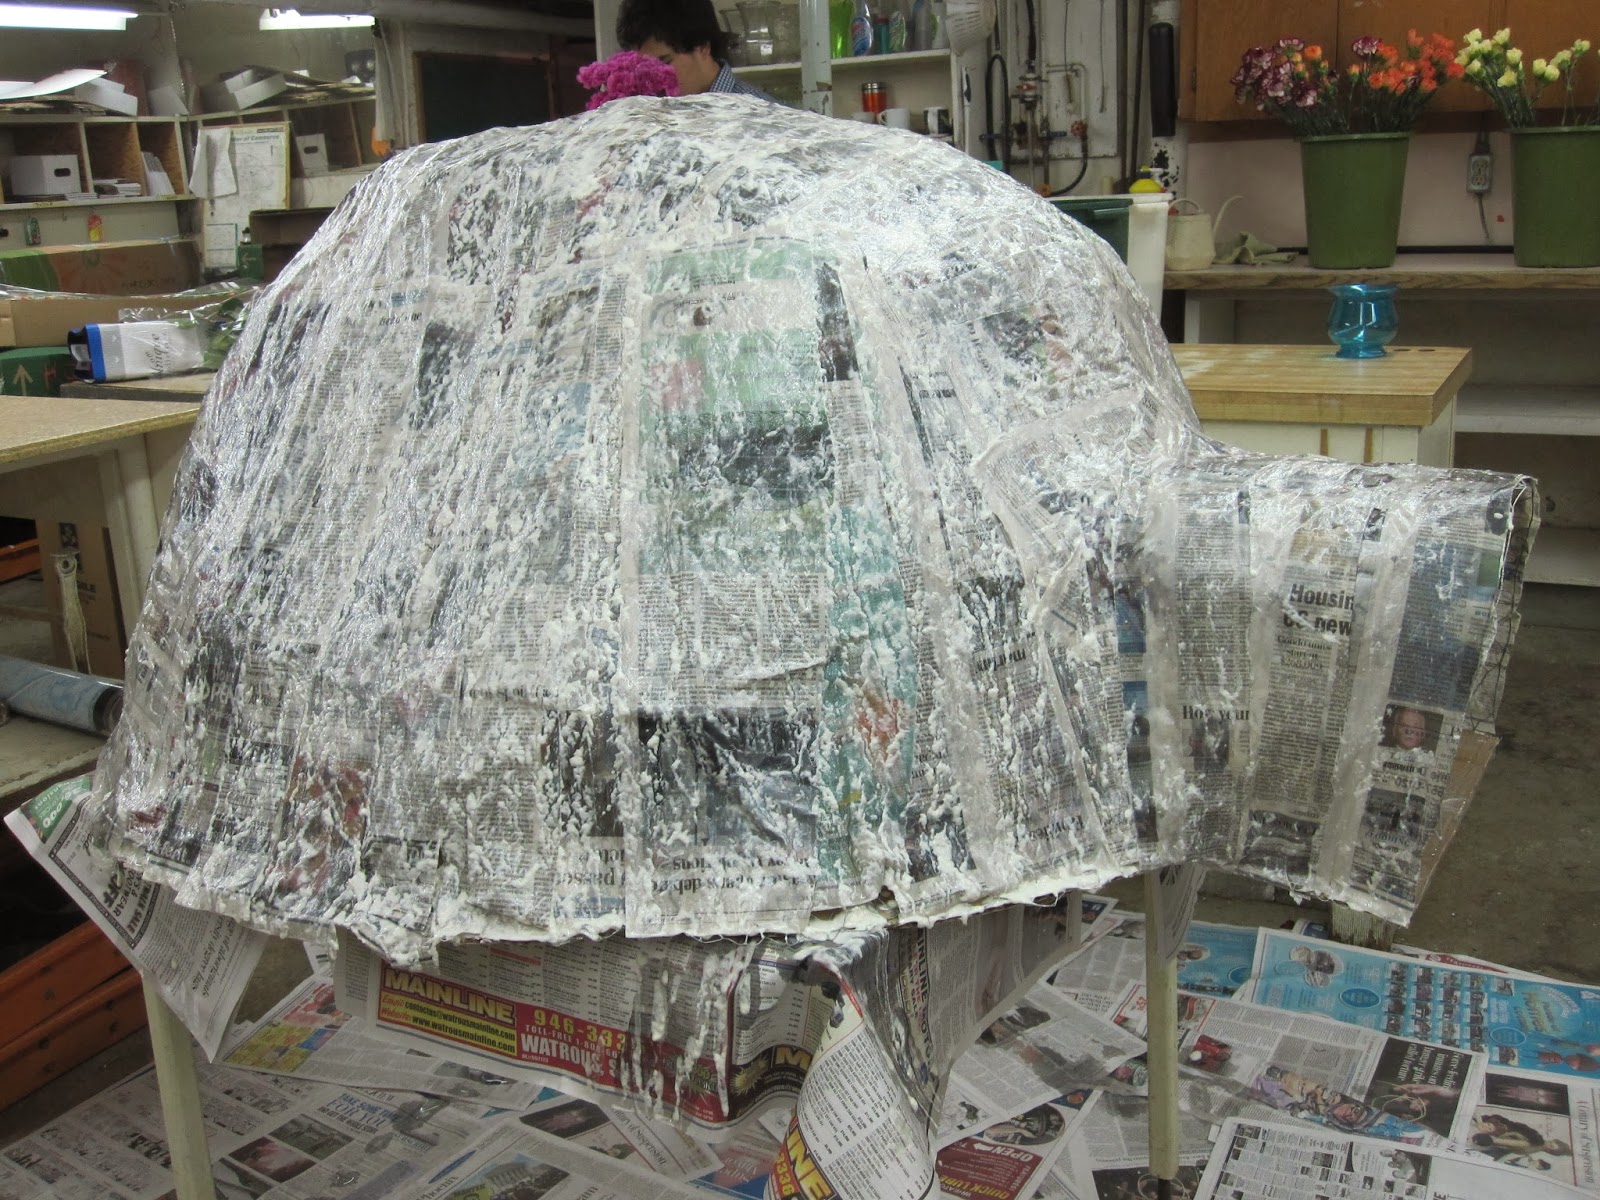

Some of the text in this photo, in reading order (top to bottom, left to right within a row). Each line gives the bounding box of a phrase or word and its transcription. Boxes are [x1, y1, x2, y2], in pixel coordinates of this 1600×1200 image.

[384, 967, 516, 1028] MAINLINE
[405, 1001, 515, 1042] contactus@watrousmainline.com
[412, 1016, 515, 1054] www.watrousmainline.com
[992, 1144, 1034, 1163] OPEN
